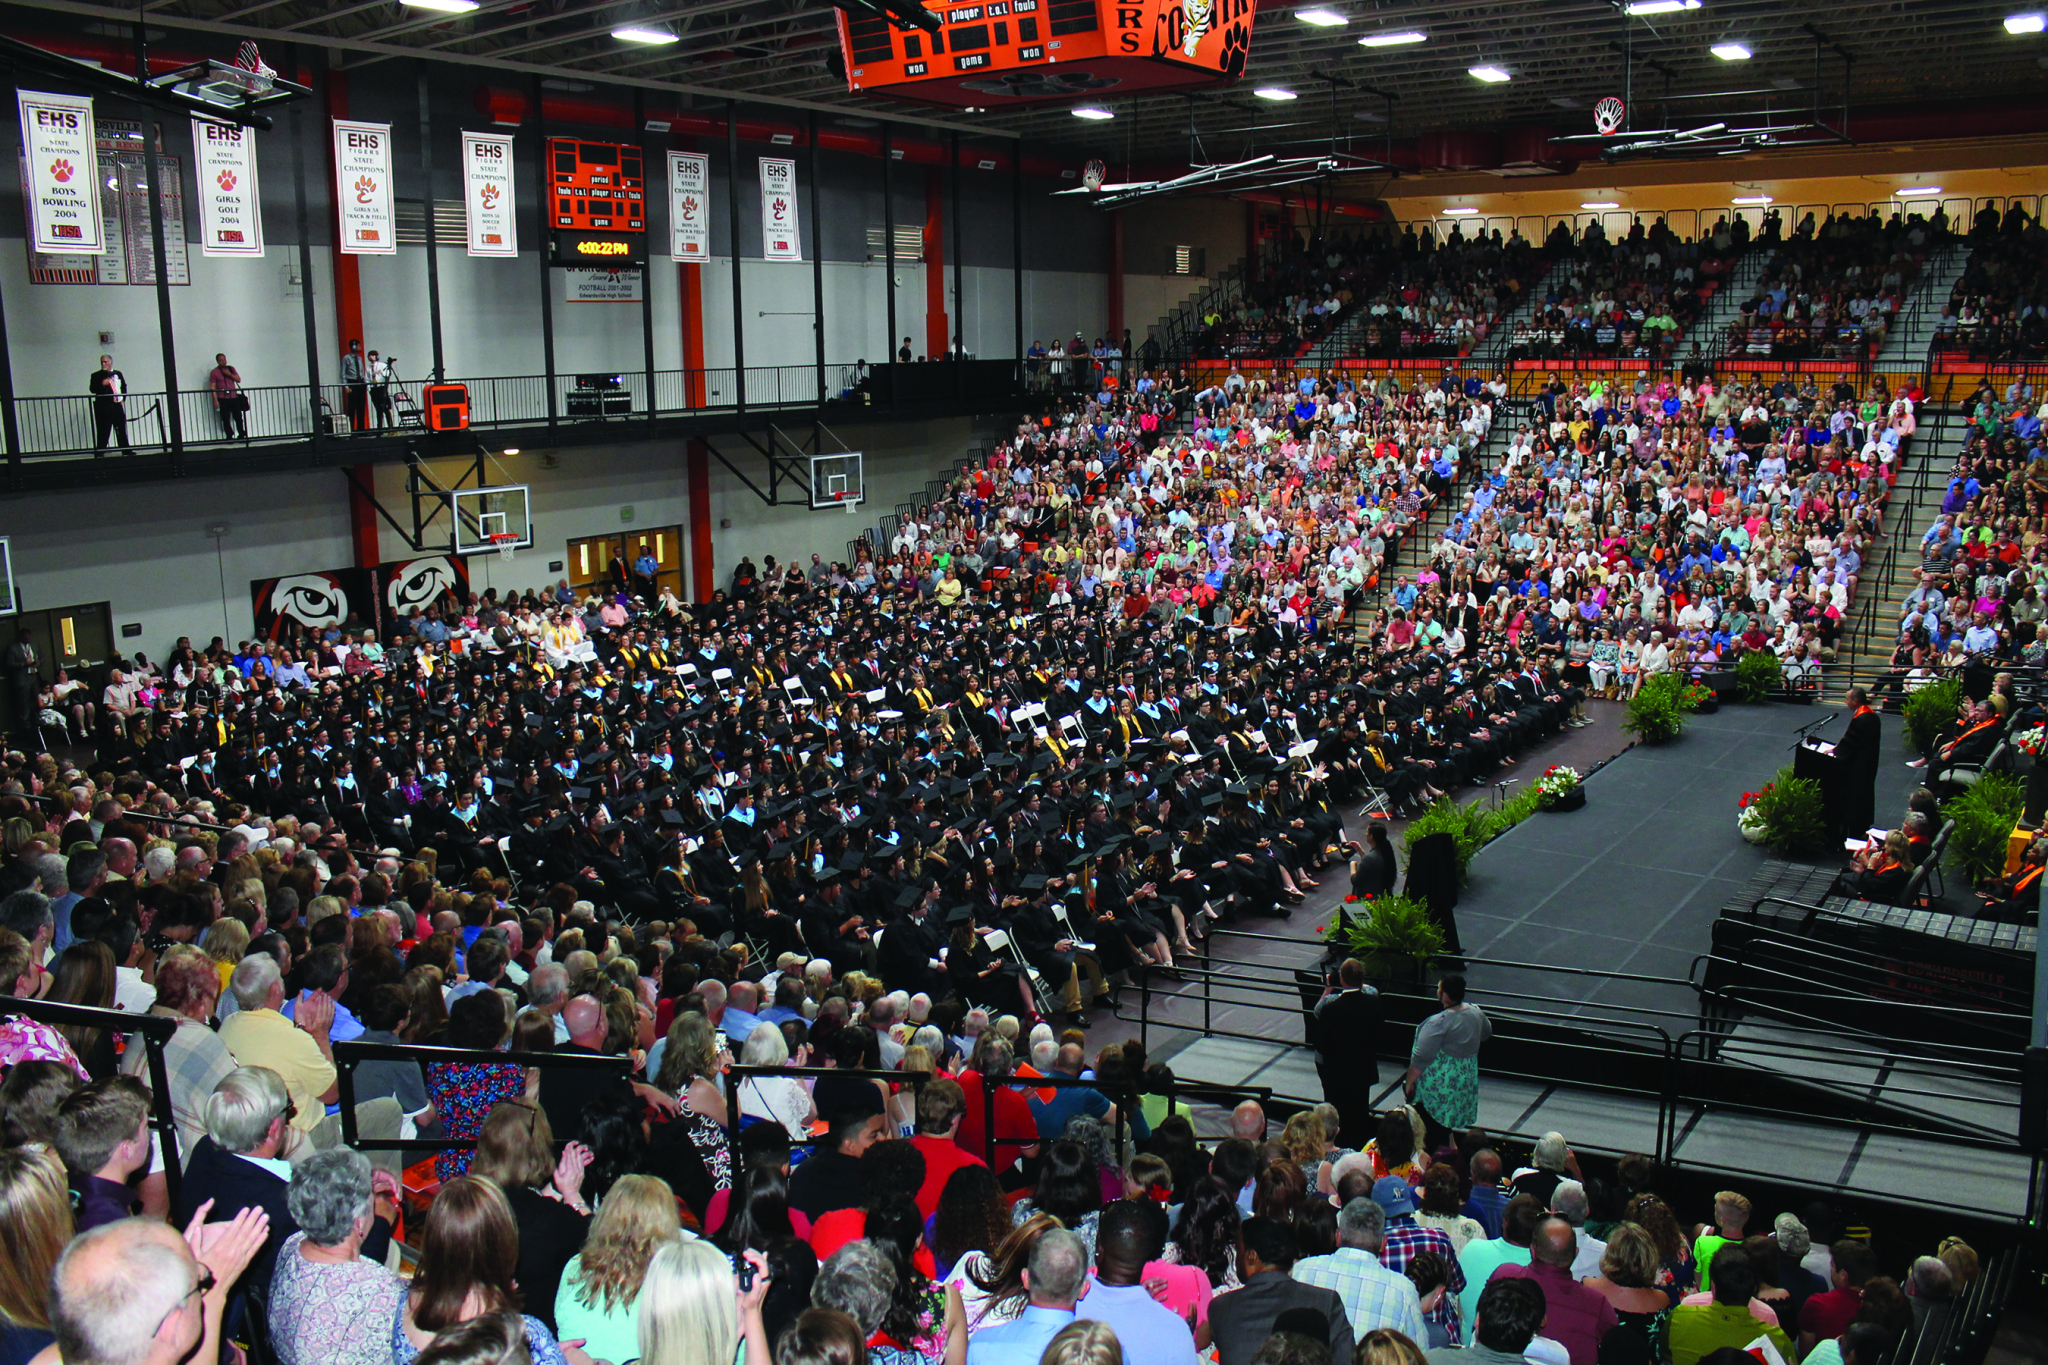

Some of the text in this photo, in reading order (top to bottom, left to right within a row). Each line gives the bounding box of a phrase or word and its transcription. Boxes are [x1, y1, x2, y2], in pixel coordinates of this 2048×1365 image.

[1014, 0, 1036, 13] fouls
[951, 7, 980, 23] player
[1022, 47, 1040, 59] won
[960, 55, 983, 70] game
[908, 63, 924, 75] won
[37, 110, 78, 128] EHS
[38, 126, 79, 135] TIGERS
[206, 125, 242, 141] EHS
[49, 139, 70, 147] STATE
[207, 140, 242, 148] TIGERS
[347, 133, 379, 149] EHS
[40, 146, 81, 155] CHAMPIONS
[475, 143, 503, 158] EHS
[475, 157, 503, 165] TIGERS
[343, 165, 385, 173] CHAMPIONS
[677, 161, 700, 174] EHS
[767, 165, 788, 177] EHS
[471, 173, 507, 181] CHAMPIONS
[591, 176, 609, 185] period
[51, 187, 77, 196] BOYS
[591, 189, 609, 197] player
[42, 198, 87, 208] BOWLING
[53, 209, 77, 218] 2004
[218, 206, 240, 214] GOLF
[577, 241, 629, 255] 4:00:22 PM
